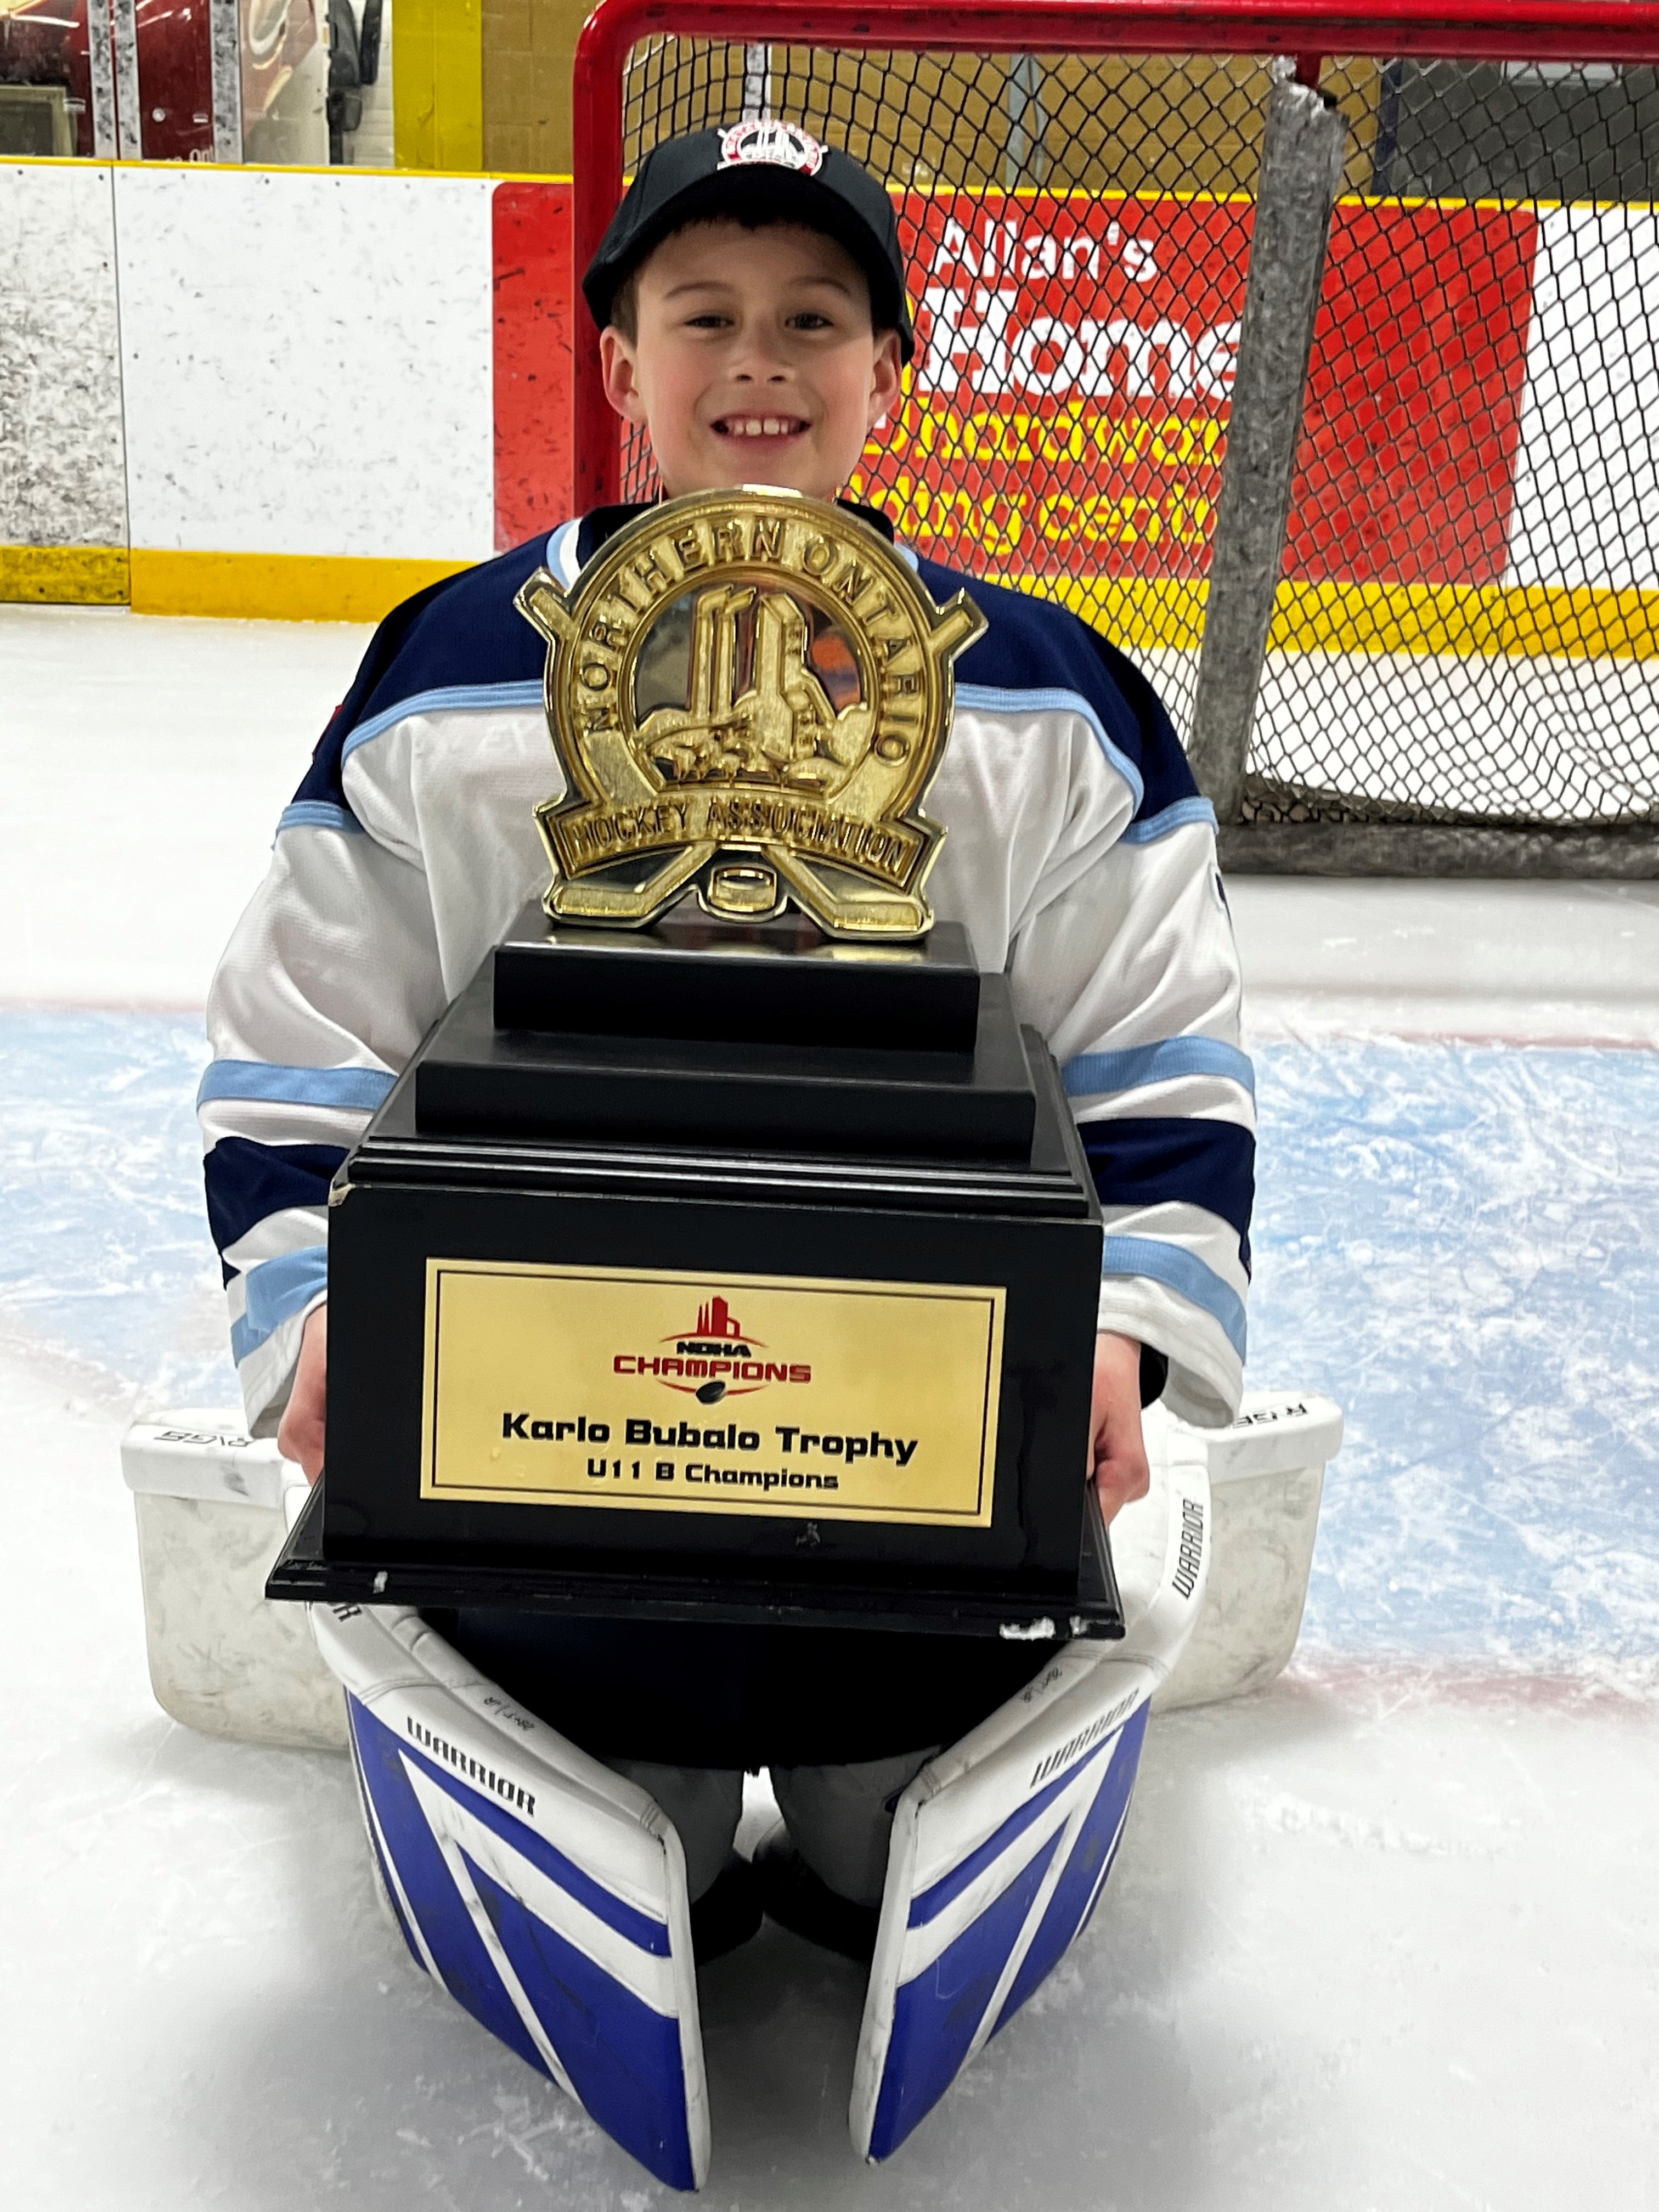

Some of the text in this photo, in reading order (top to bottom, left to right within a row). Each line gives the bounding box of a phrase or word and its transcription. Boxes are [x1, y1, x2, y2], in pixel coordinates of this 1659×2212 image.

[929, 219, 1158, 282] Allan's
[919, 287, 1242, 402] Home
[913, 397, 1229, 465] hardwar
[582, 518, 921, 764] NORTHERN ONTARIO
[573, 800, 905, 868] HOCKEY ASSOCIATION
[613, 1355, 811, 1384] CHAMPIONS
[676, 1341, 752, 1358] NOHA
[503, 1413, 918, 1467] Karlo Bubalo Trophy
[587, 1458, 839, 1492] U11 B Champions
[1171, 1498, 1204, 1601] WARRIOR
[406, 1716, 536, 1817] WARRIOR
